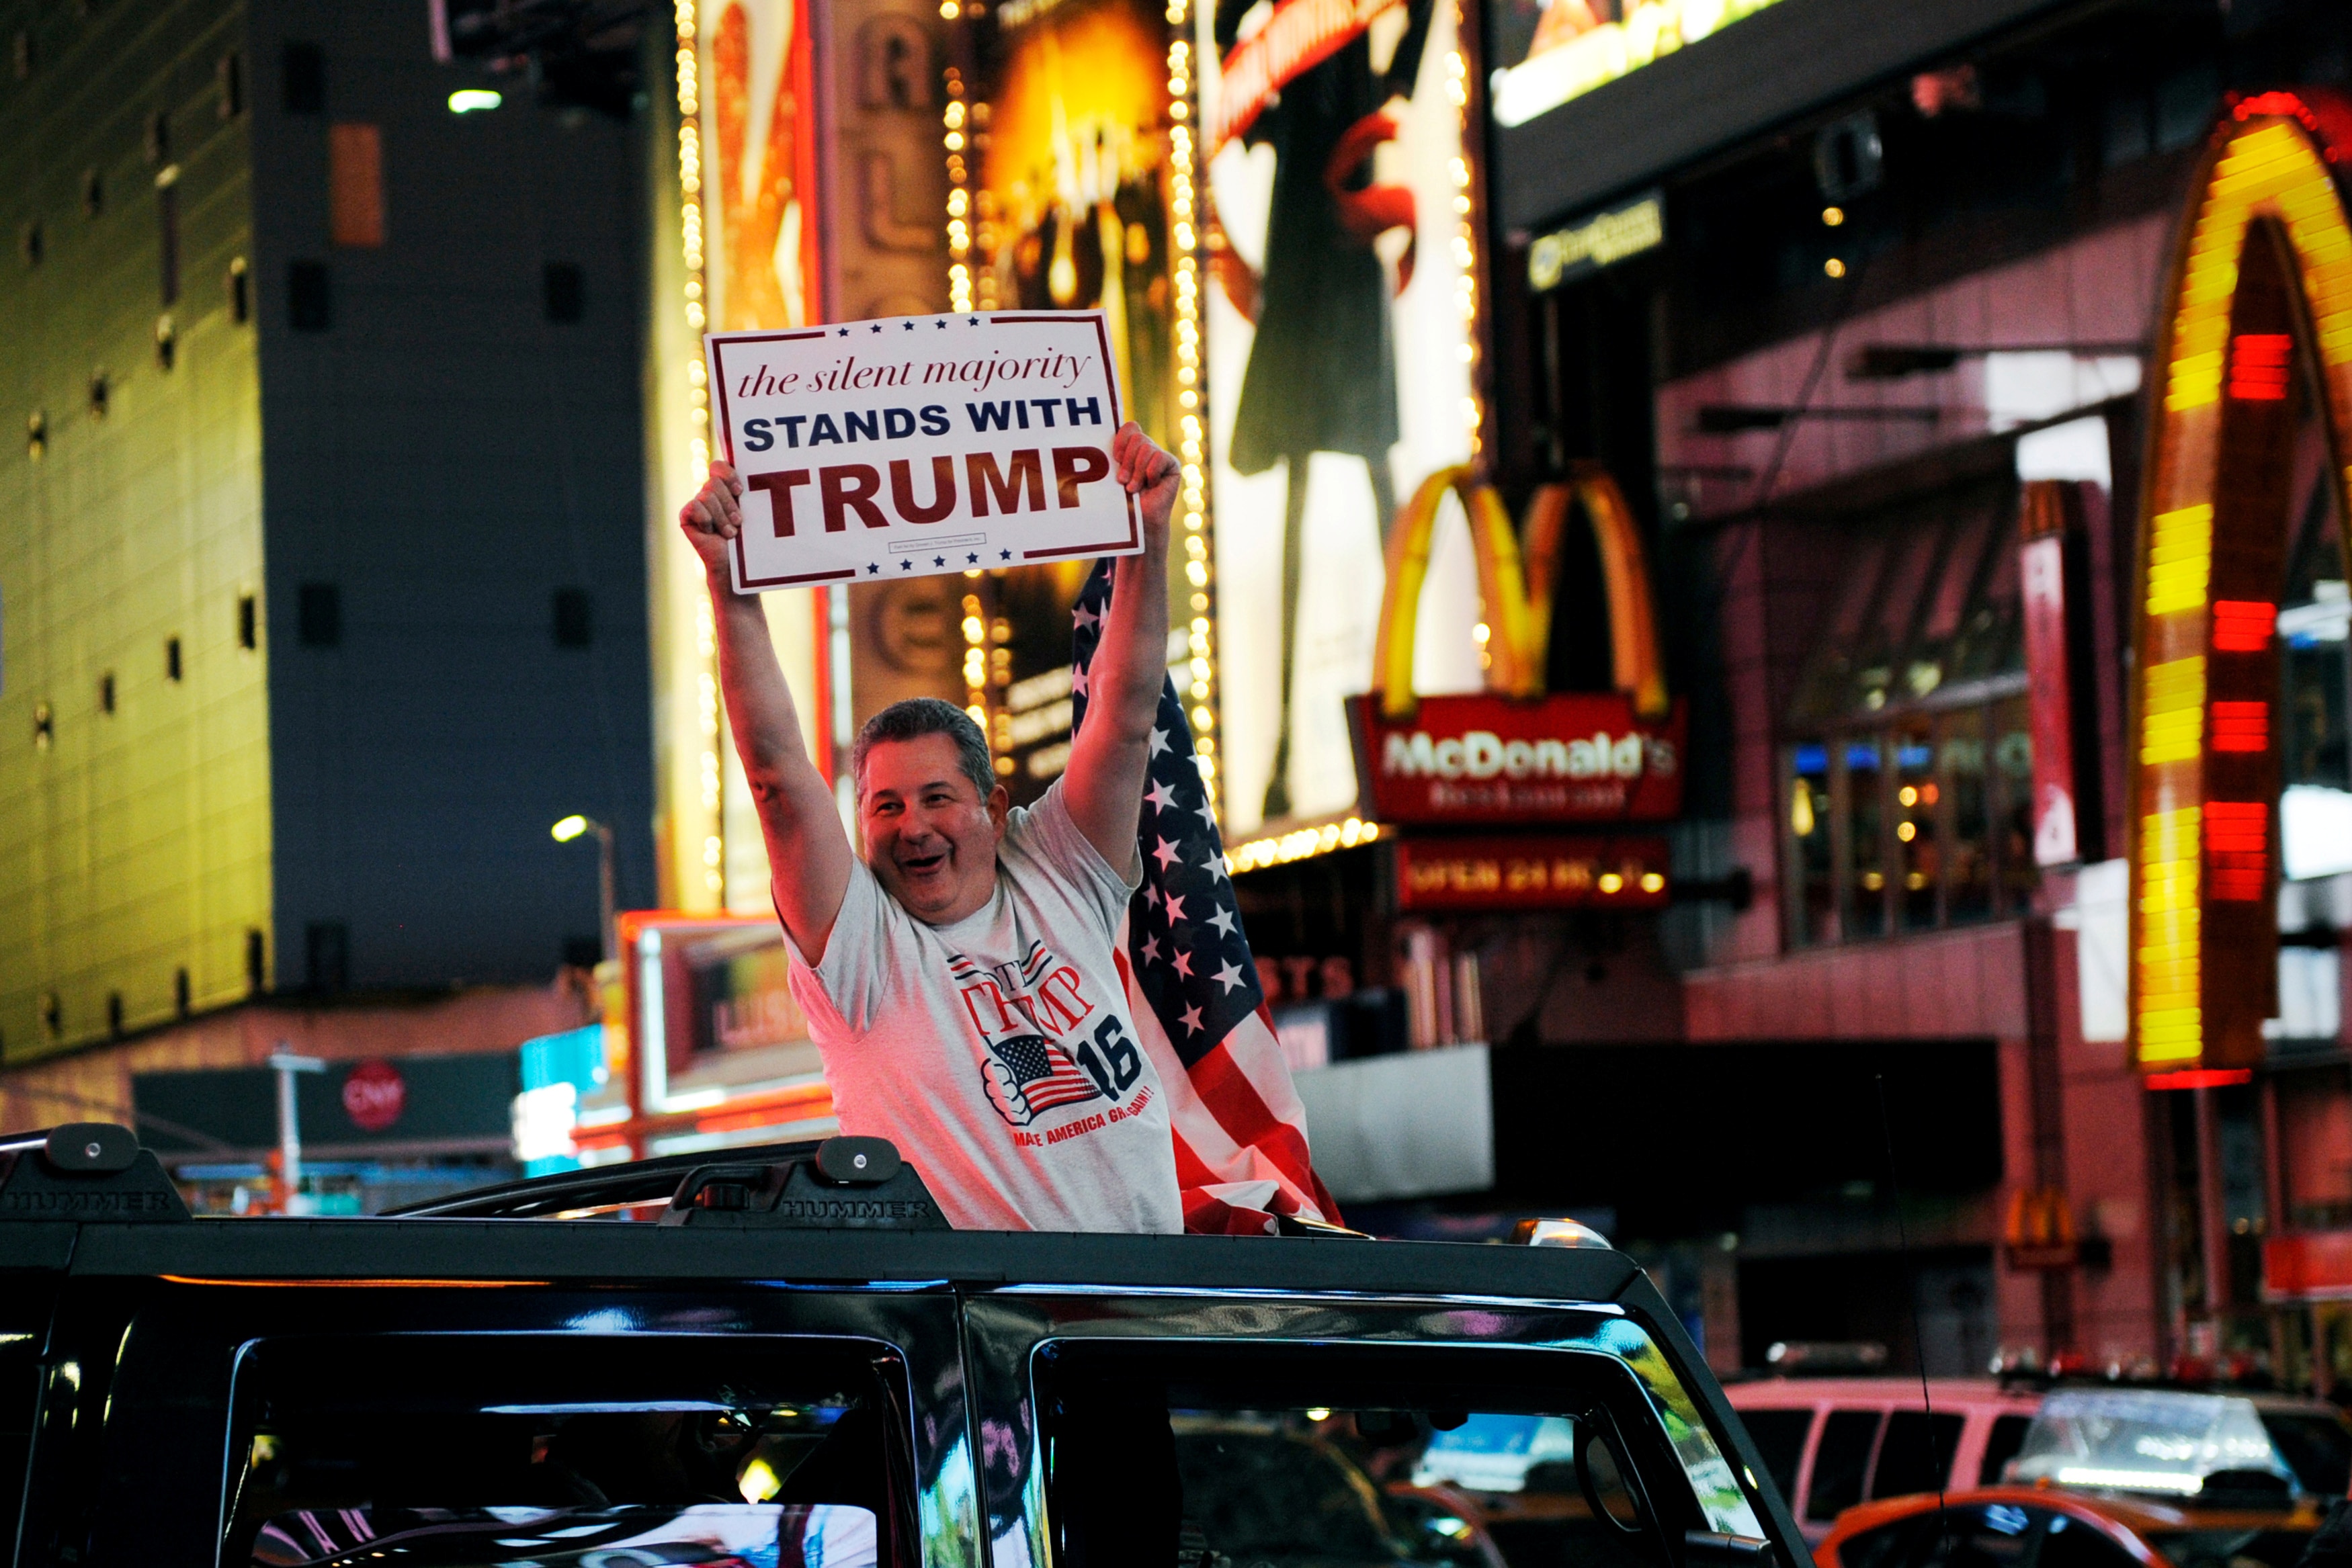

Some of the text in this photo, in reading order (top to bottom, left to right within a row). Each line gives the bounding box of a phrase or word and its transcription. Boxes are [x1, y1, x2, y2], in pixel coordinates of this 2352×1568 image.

[738, 347, 1091, 398] the silent majority
[743, 397, 1102, 451] STANDS WITH
[747, 446, 1110, 538] TRUMP
[1383, 731, 1676, 780] McDonald's
[1077, 1014, 1142, 1102] 16
[1013, 1132, 1043, 1146] MAE
[1046, 1113, 1106, 1144] AMERICA
[6, 1191, 169, 1210] HUMMER
[782, 1201, 929, 1218] HUMMER
